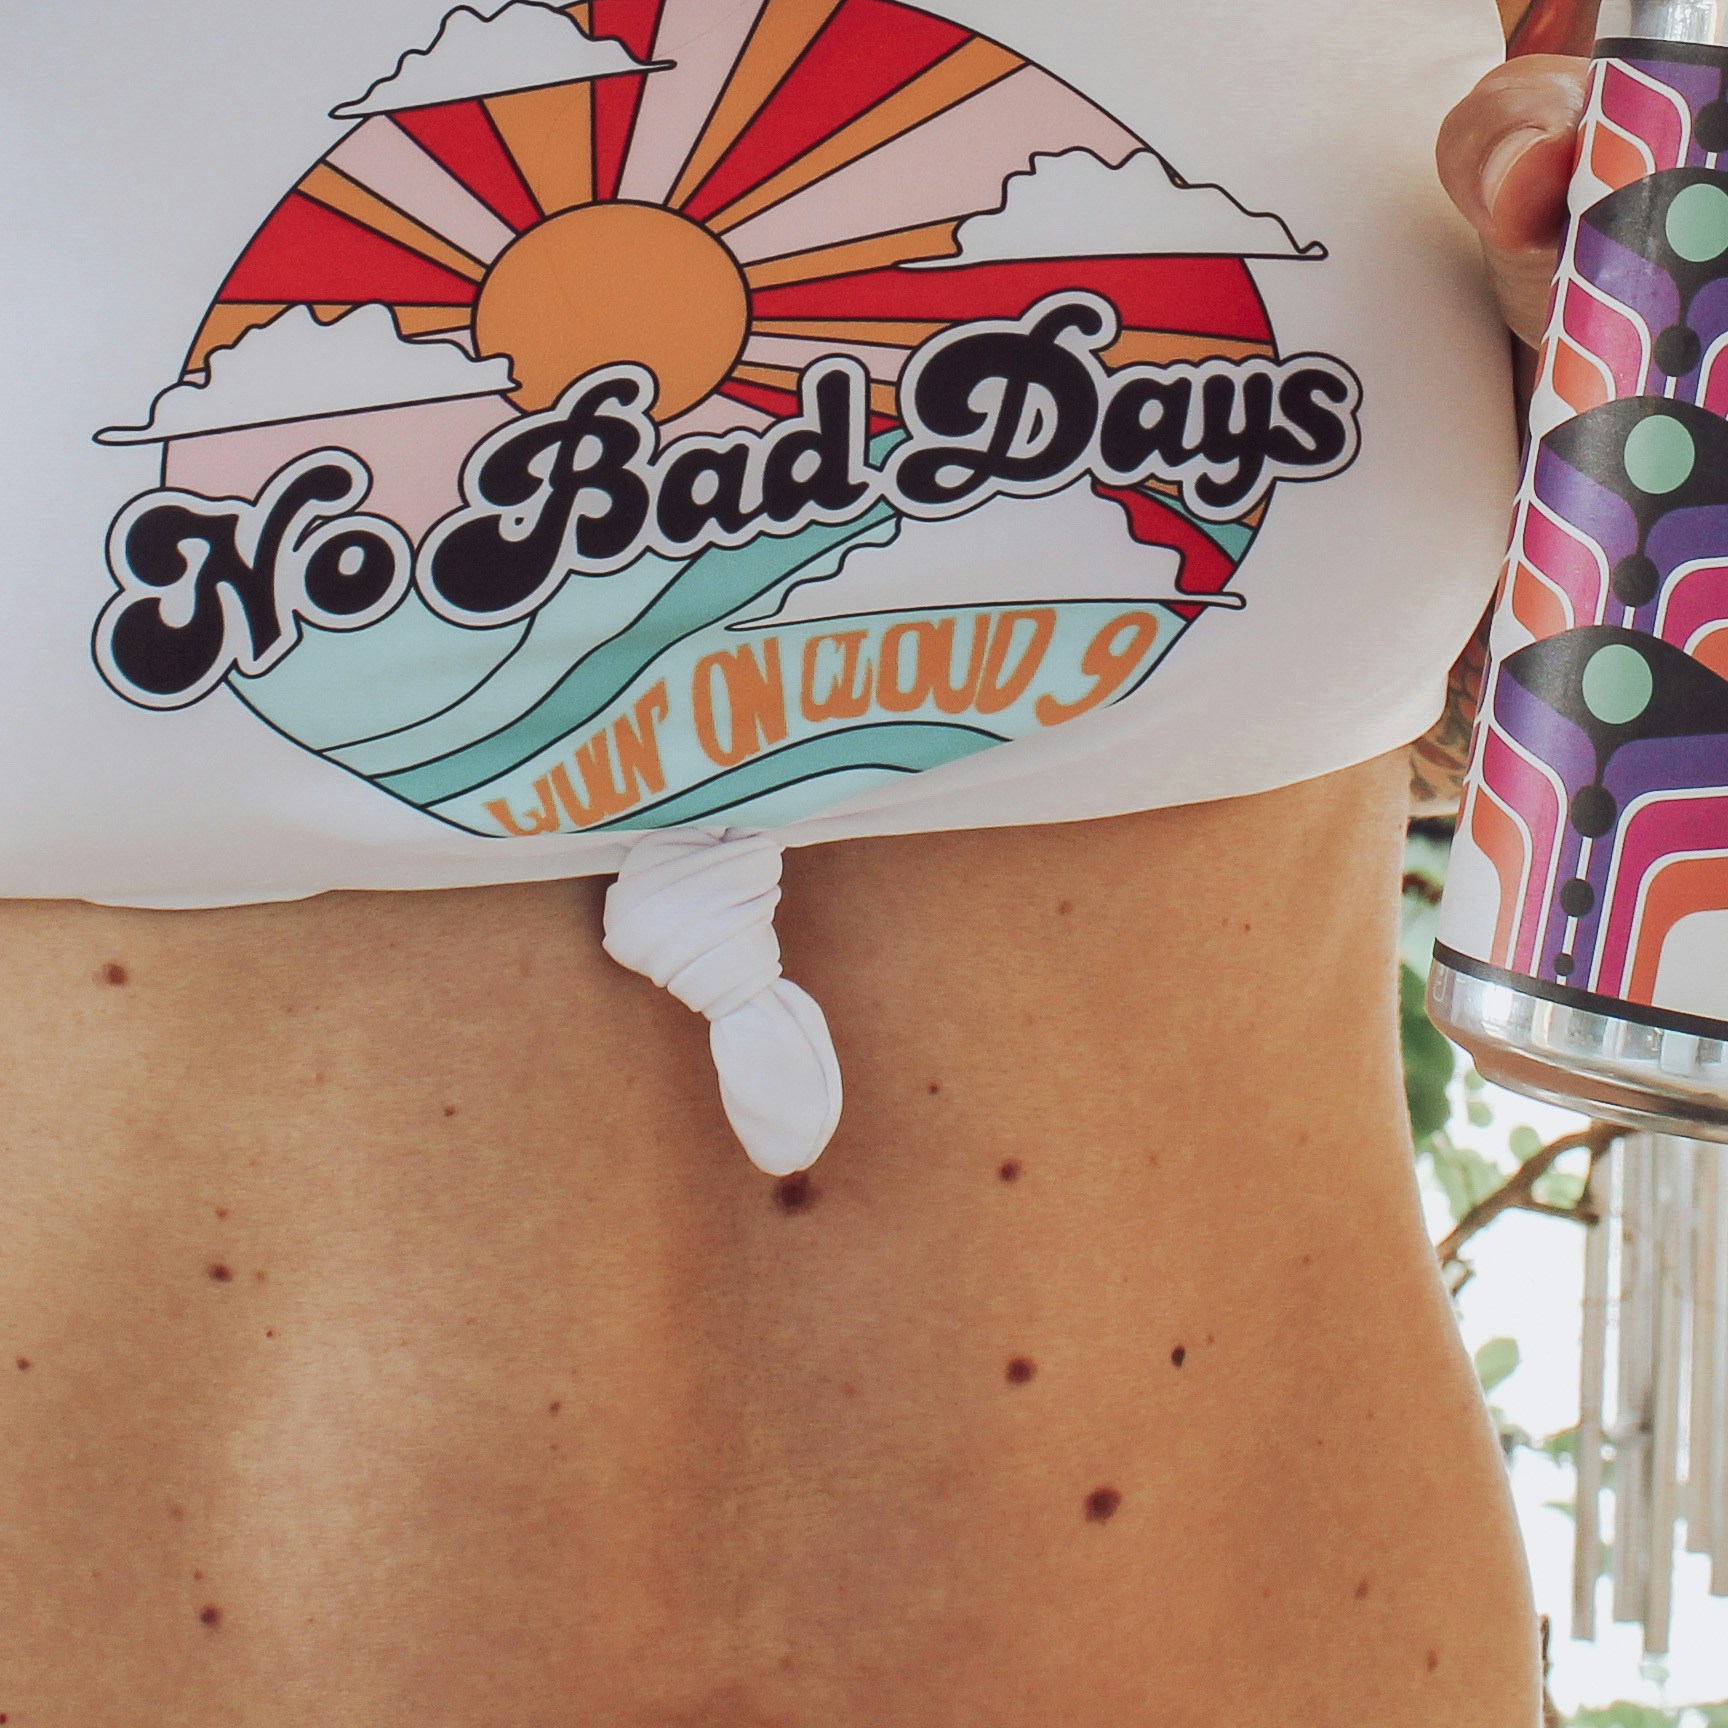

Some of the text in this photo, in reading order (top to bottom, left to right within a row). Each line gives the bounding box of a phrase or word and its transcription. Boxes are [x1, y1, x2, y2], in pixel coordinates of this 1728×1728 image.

[110, 302, 1349, 696] No Bad Days
[691, 635, 789, 768] ON
[799, 607, 1057, 723] CLOUD
[1034, 610, 1160, 727] 9
